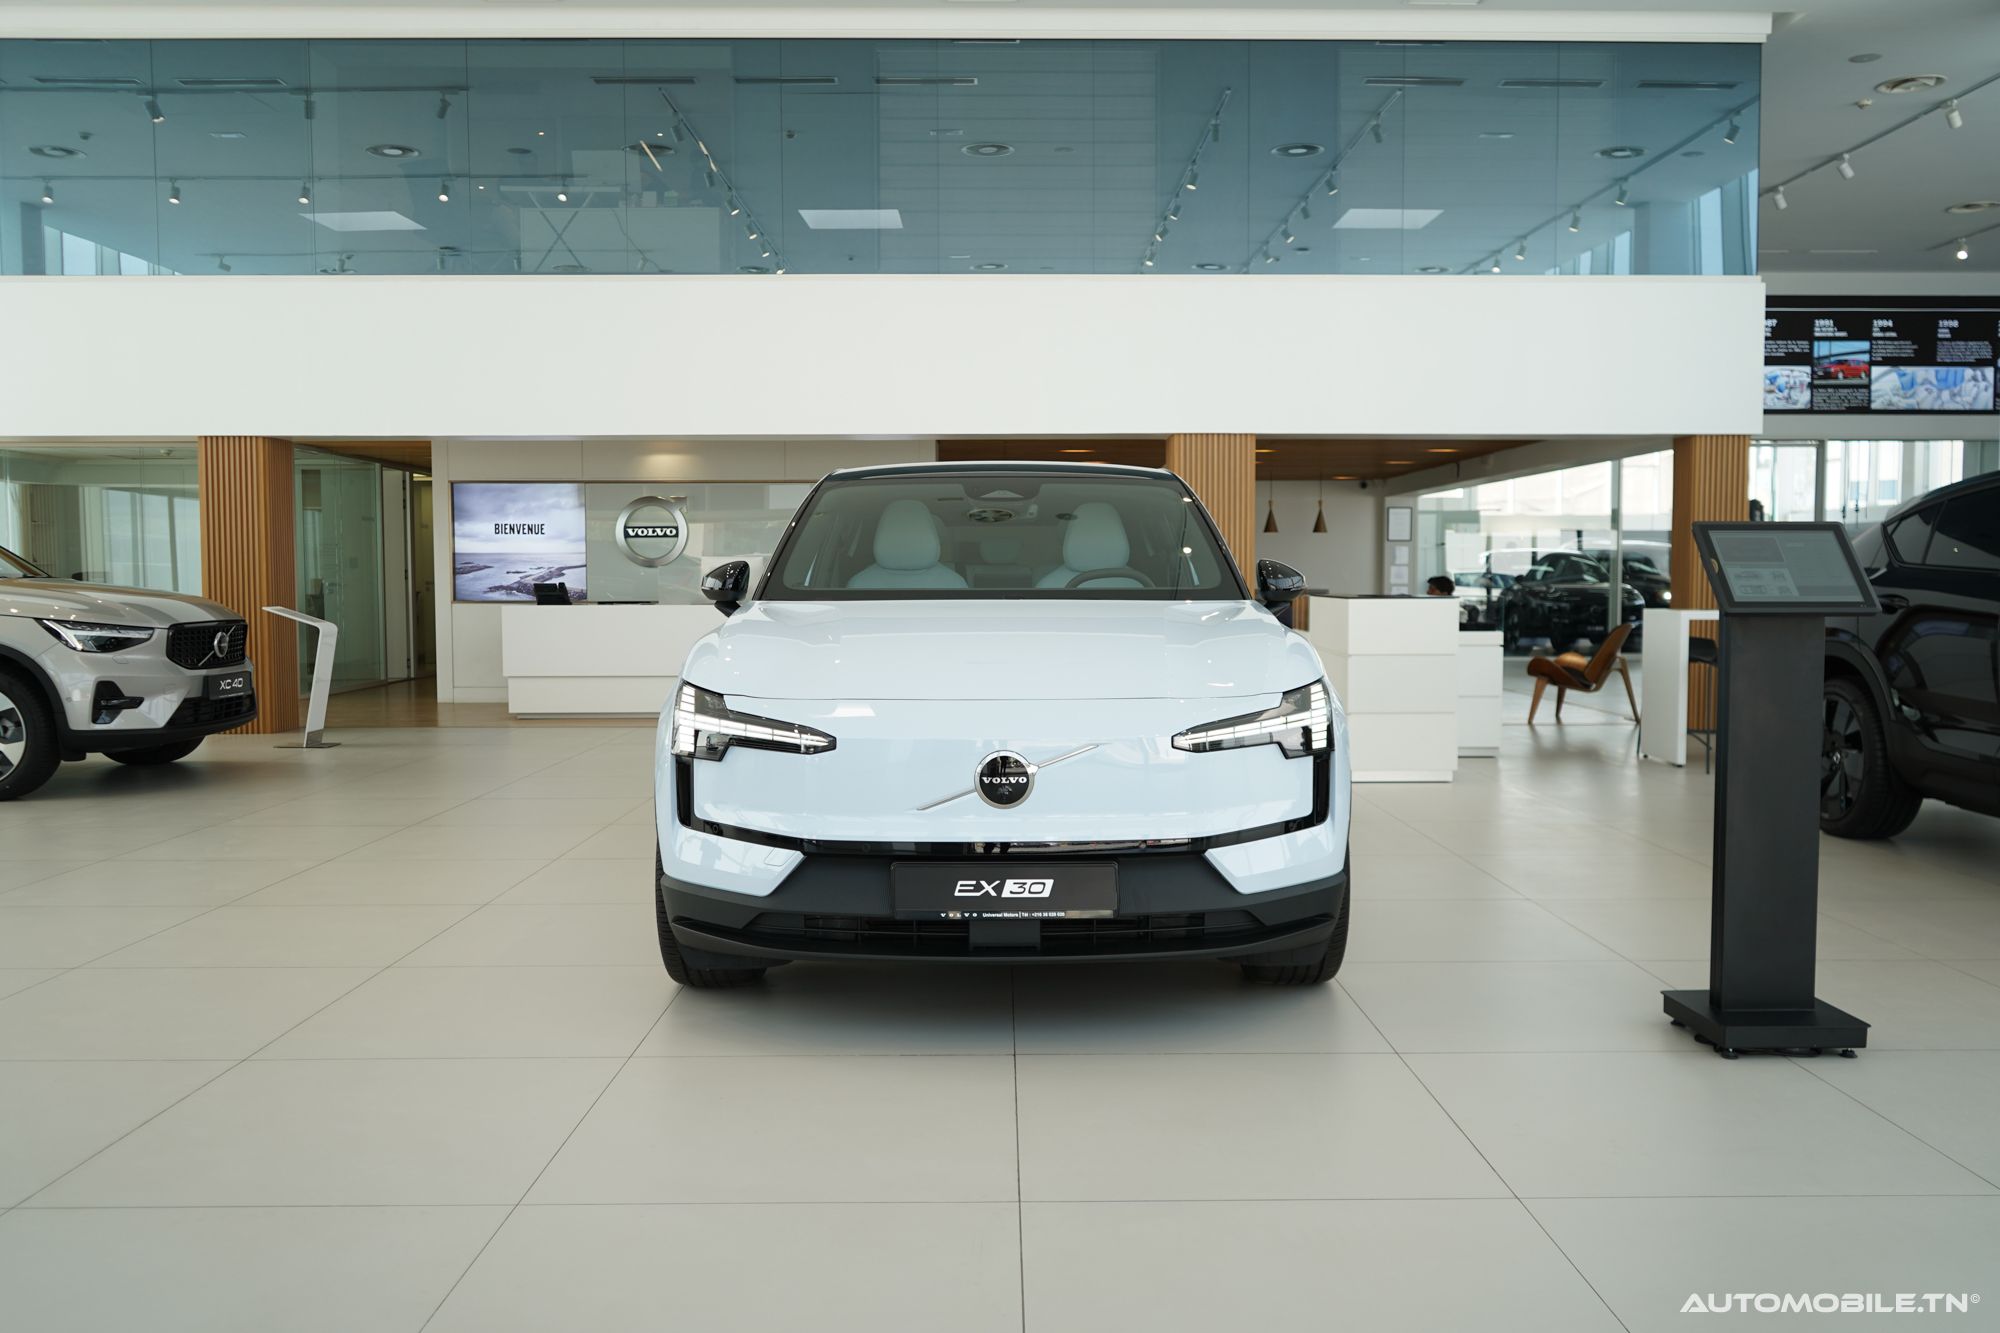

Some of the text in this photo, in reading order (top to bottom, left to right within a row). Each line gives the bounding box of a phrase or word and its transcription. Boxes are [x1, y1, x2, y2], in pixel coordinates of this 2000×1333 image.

[494, 523, 545, 535] BIENVENUE
[626, 527, 677, 537] VOLVO
[981, 776, 1027, 784] VOLVO
